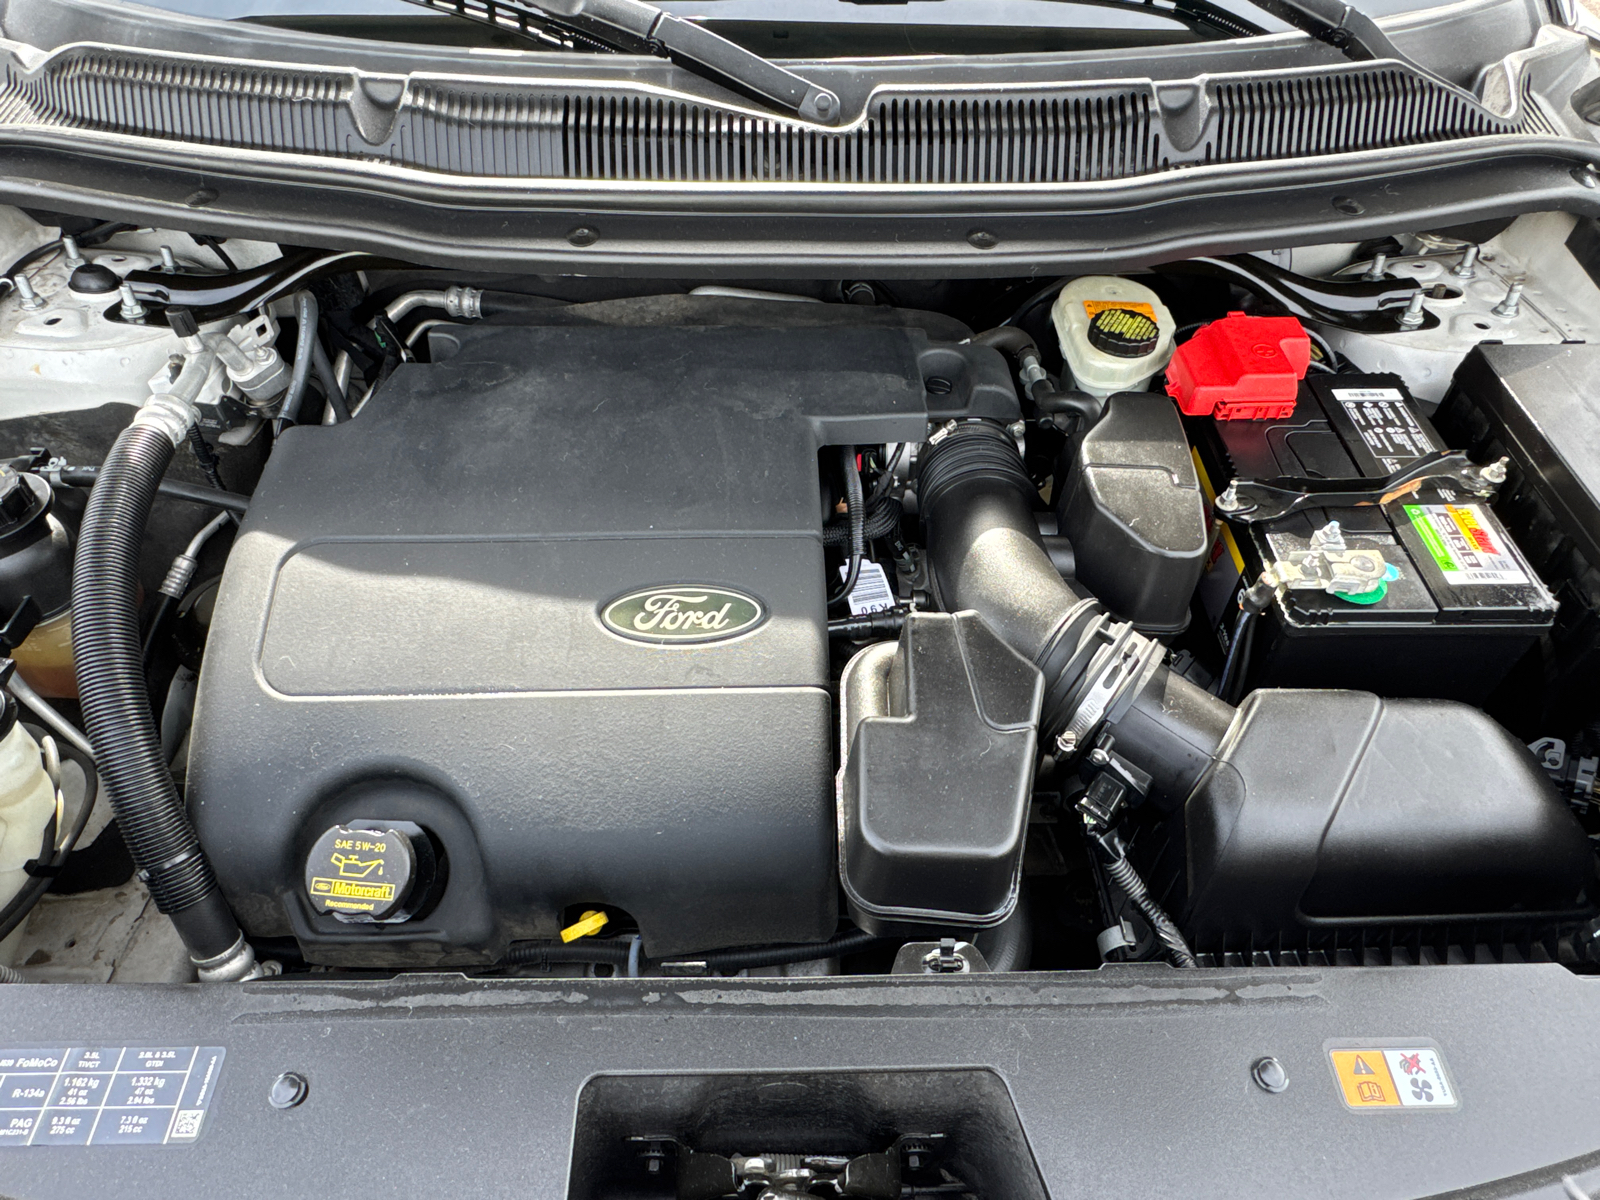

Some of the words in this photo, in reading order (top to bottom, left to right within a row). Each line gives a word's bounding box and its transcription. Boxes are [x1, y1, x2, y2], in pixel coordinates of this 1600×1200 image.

[633, 594, 732, 630] Ford
[335, 839, 354, 850] SAE
[355, 841, 387, 853] 5W-20
[334, 882, 391, 898] Motorcraft
[325, 899, 375, 911] Recommended
[16, 1057, 58, 1067] FoMoCo
[64, 1077, 87, 1087] 1.162
[87, 1078, 100, 1089] kg
[131, 1077, 154, 1086] 1.332
[154, 1077, 166, 1088] kg
[12, 1088, 45, 1098] R-134a
[67, 1088, 78, 1096] 41
[134, 1087, 144, 1095] 47
[10, 1118, 33, 1128] PAG
[50, 1126, 66, 1134] 275
[118, 1125, 134, 1133] 215
